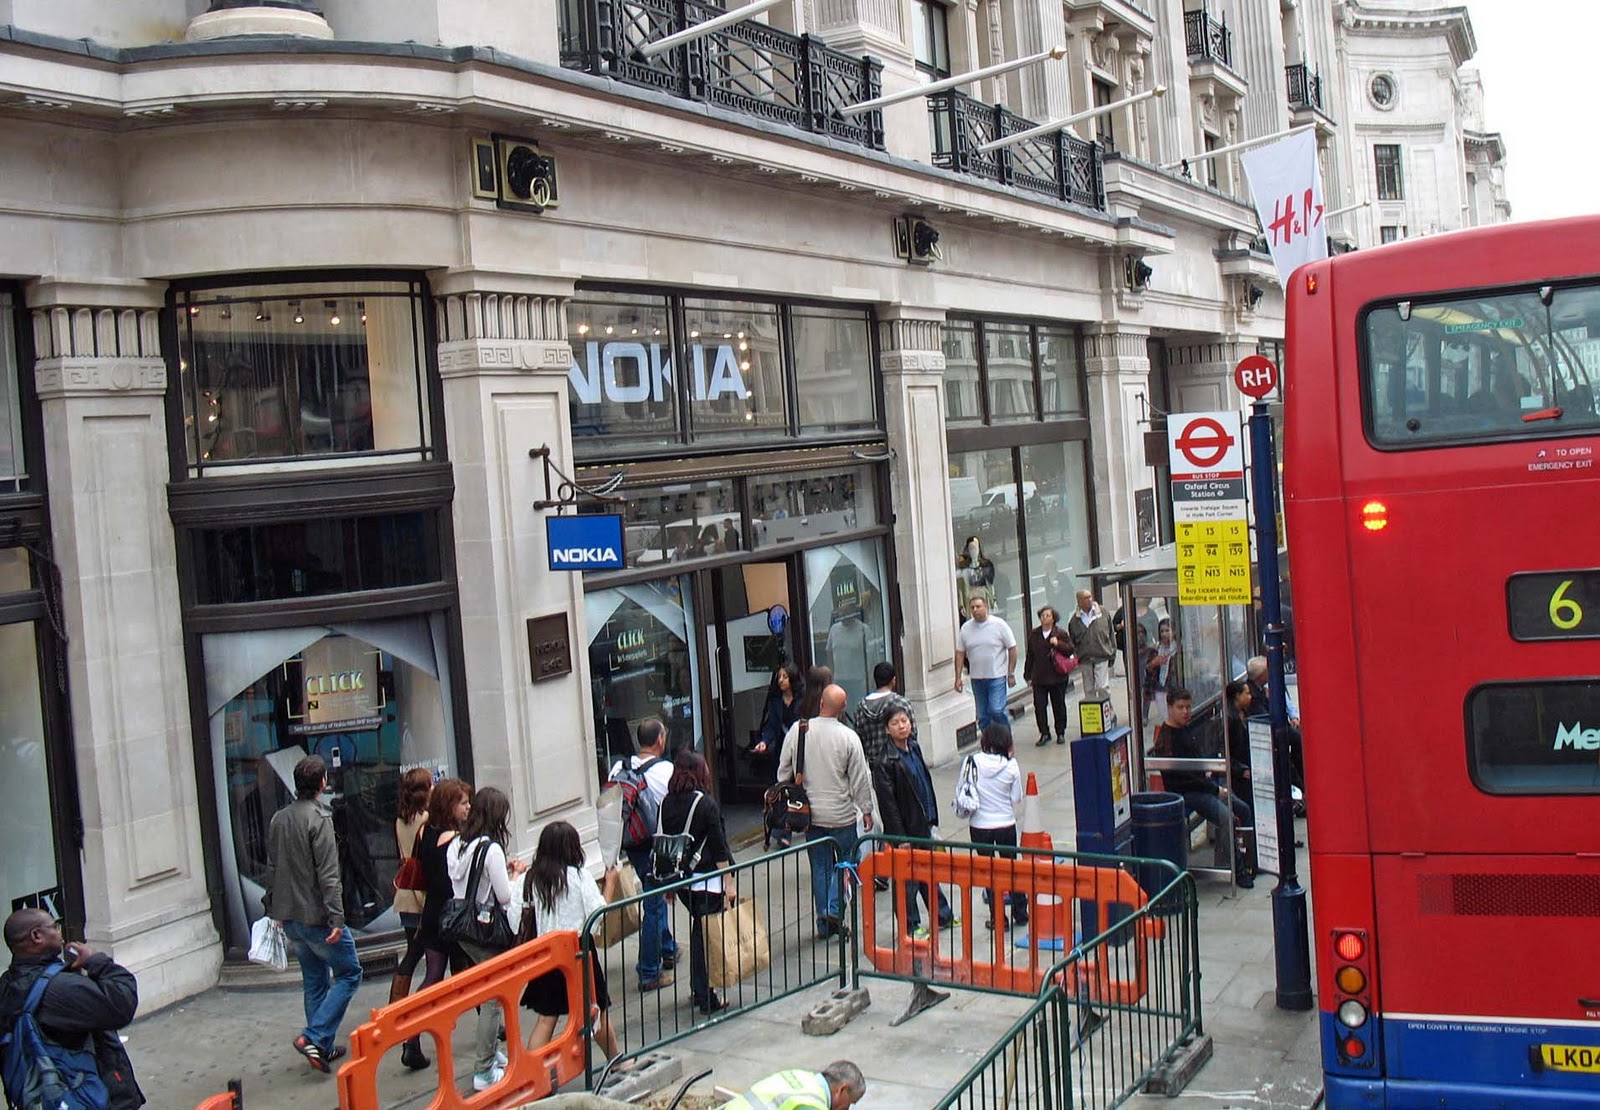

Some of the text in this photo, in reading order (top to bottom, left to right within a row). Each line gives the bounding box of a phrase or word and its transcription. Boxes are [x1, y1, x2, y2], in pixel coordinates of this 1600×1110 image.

[1450, 319, 1517, 332] EMERGENCY EXIT
[568, 341, 748, 404] NOKIA
[1241, 366, 1272, 388] RH
[1556, 447, 1592, 456] TO OPEN
[1528, 460, 1593, 471] EMERGENCY EXIT
[1191, 490, 1216, 498] Station
[1206, 527, 1215, 535] 13
[1230, 526, 1239, 535] 15
[553, 547, 619, 564] NOKIA
[1183, 547, 1243, 557] 23 94 139
[1183, 568, 1246, 578] C2 N13 N15
[1549, 580, 1583, 630] 6
[617, 627, 646, 651] CLICK
[305, 670, 365, 696] CLICK
[1553, 720, 1600, 751] Me
[1464, 1025, 1503, 1033] EMERGENCY
